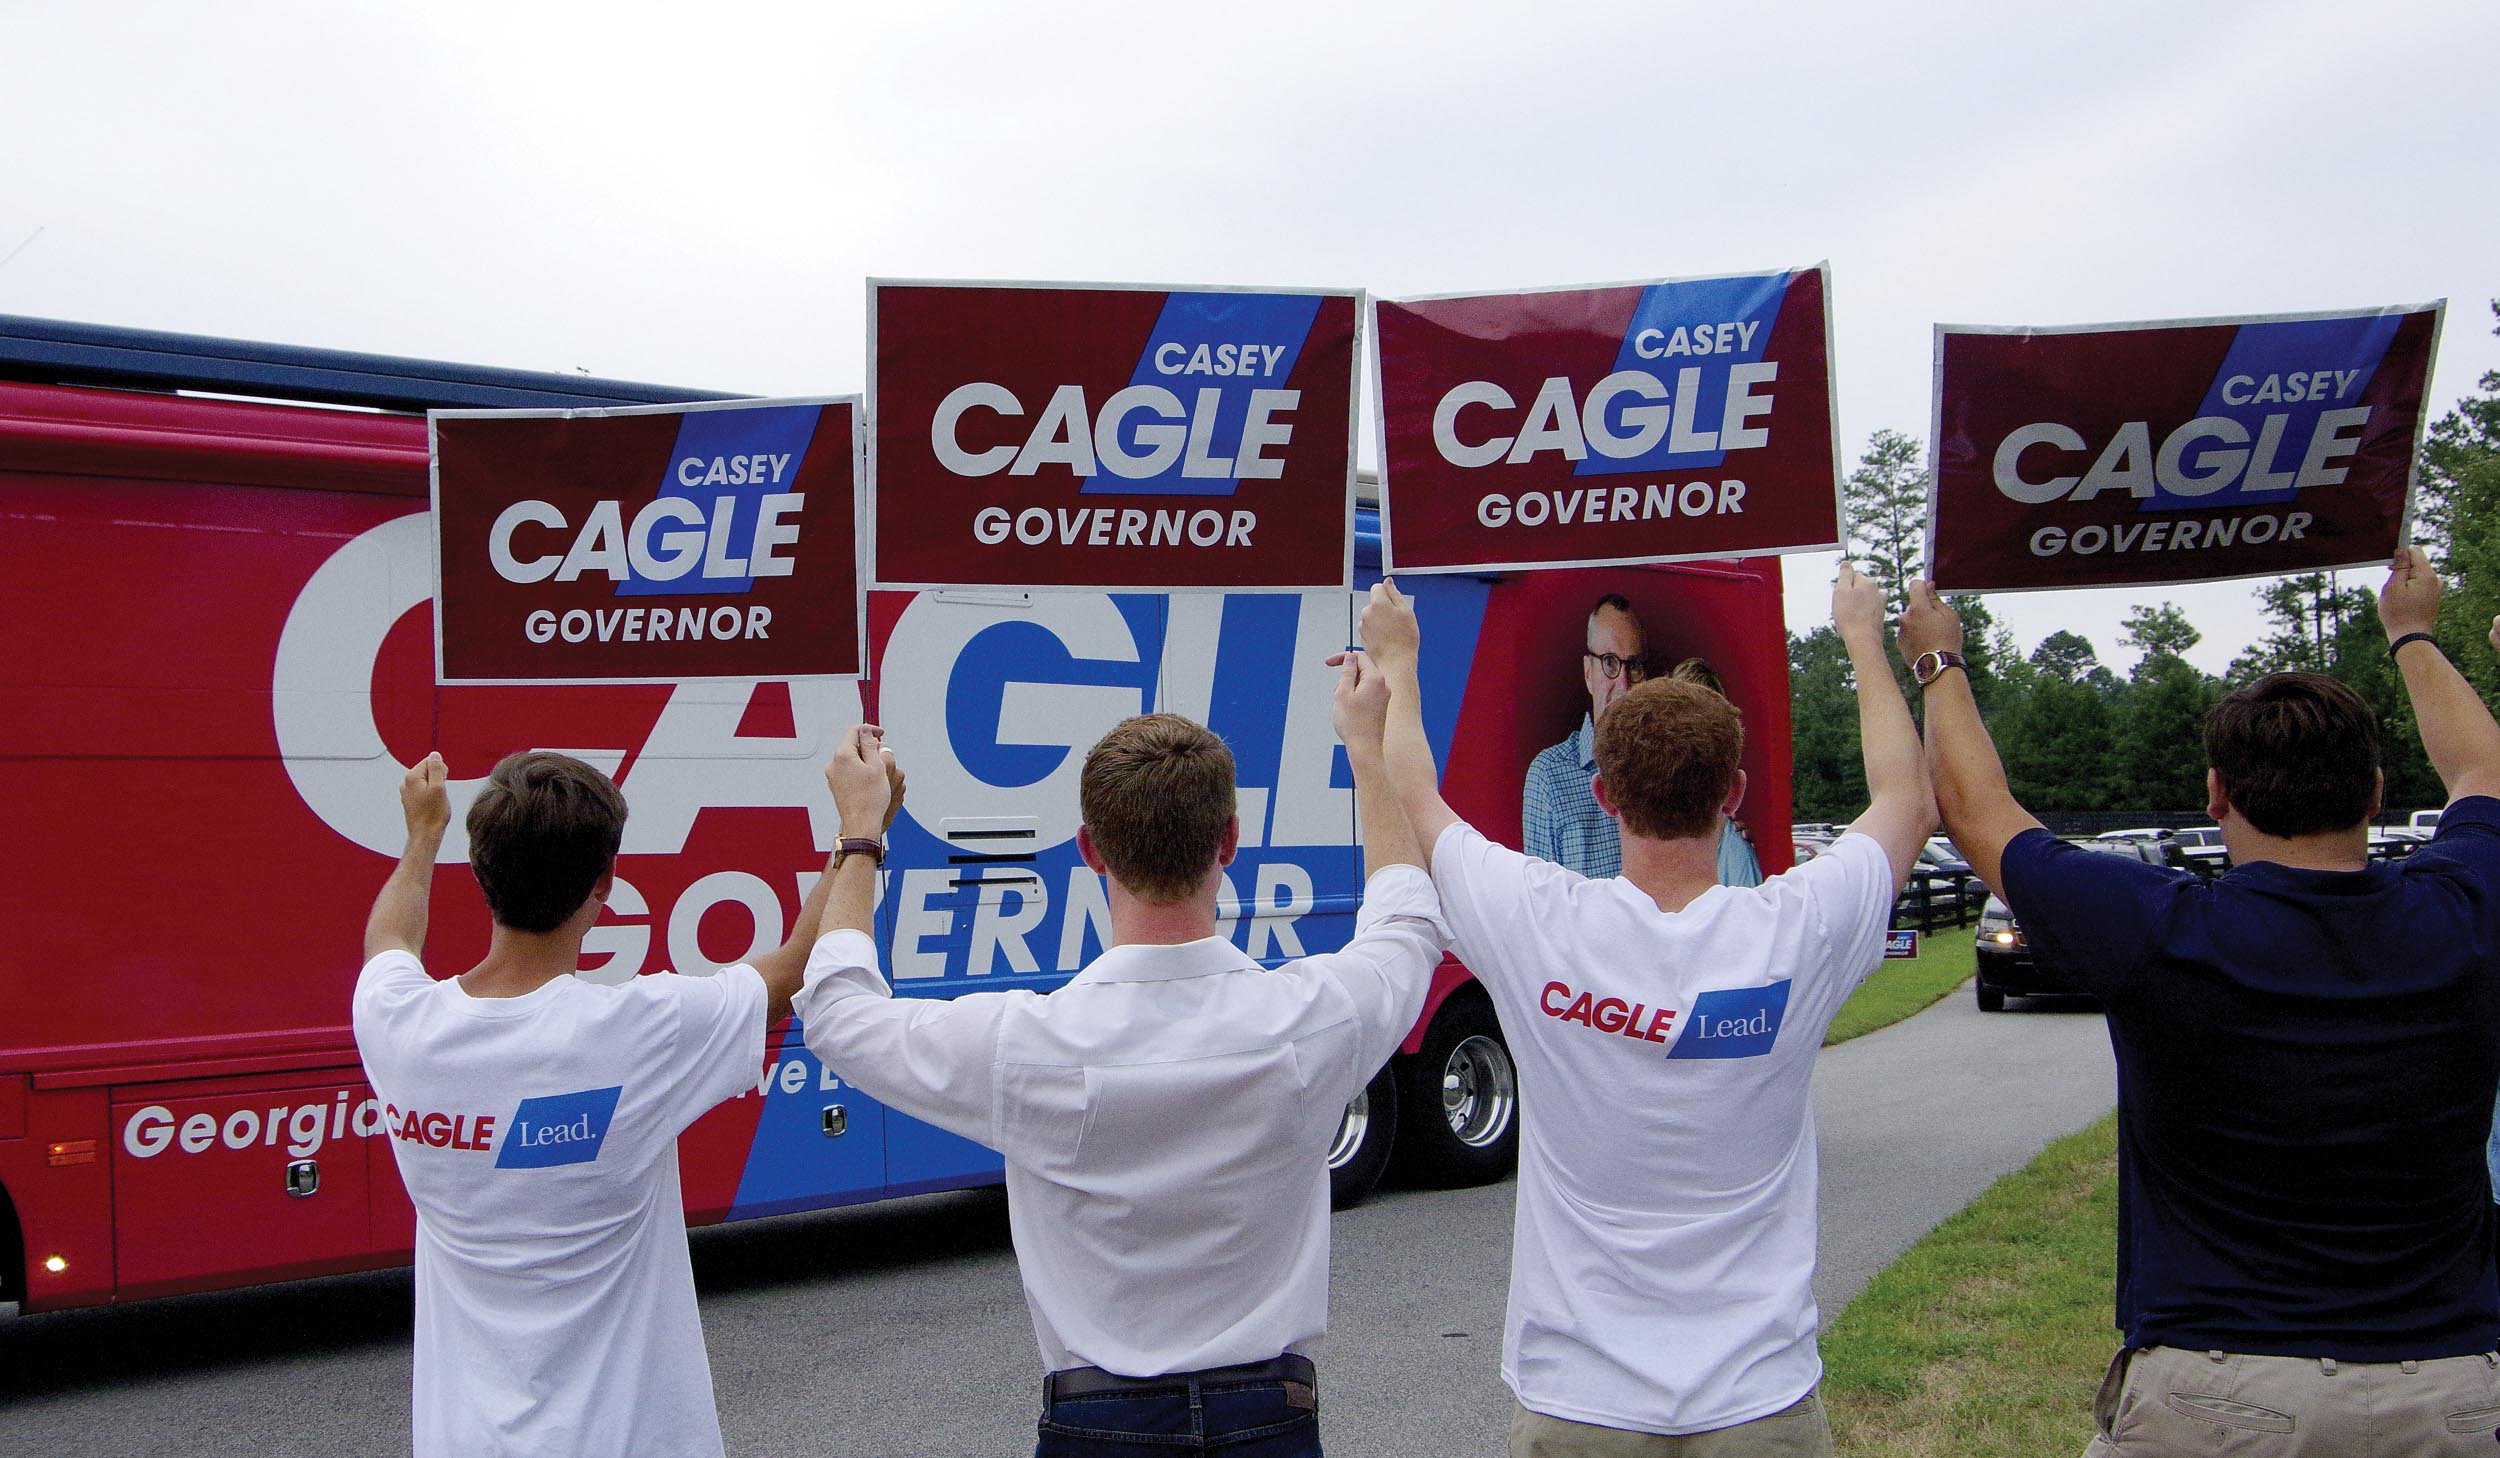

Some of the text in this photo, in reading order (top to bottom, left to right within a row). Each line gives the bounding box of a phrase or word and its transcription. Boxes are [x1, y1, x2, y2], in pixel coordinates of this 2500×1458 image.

[1154, 342, 1286, 377] CASEY
[1634, 320, 1761, 359] CASEY
[2222, 368, 2361, 406] CASEY
[931, 381, 1302, 480] CAGLE
[1432, 360, 1779, 468] CAGLE
[677, 453, 791, 487] CASEY
[1993, 405, 2373, 505] CAGLE
[973, 506, 1257, 547] GOVERNOR
[1476, 479, 1747, 529] GOVERNOR
[488, 492, 806, 584] CAGLE
[2029, 511, 2313, 557] GOVERNOR
[524, 605, 773, 644] GOVERNOR
[576, 863, 1313, 982] GOERNR
[1886, 939, 1912, 950] AGLE
[1540, 980, 1772, 1044] CAGLE Lead.
[386, 1103, 597, 1152] CAGLE Lead.
